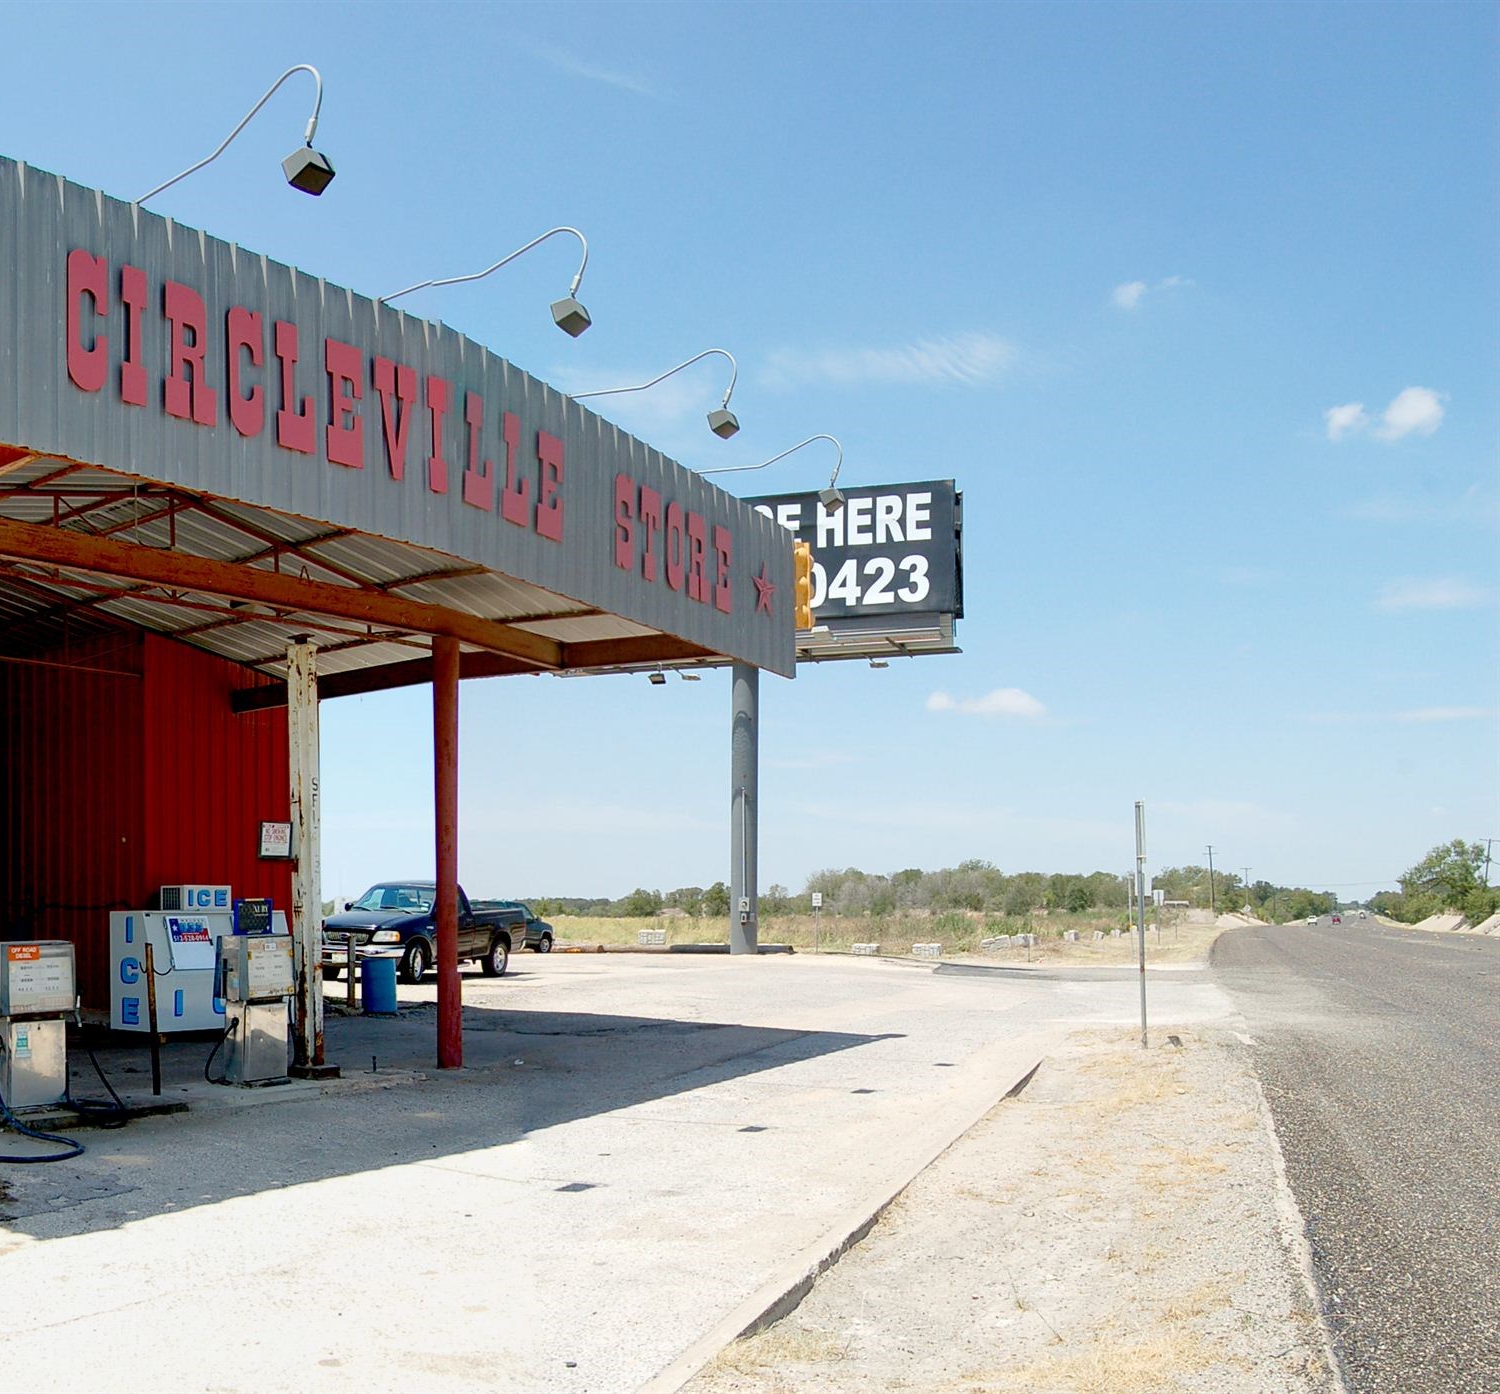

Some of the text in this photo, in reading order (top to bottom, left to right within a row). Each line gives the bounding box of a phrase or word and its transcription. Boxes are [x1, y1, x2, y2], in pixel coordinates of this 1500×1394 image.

[67, 248, 733, 614] CIRCLEVILLE STORE
[816, 492, 932, 549] HERE
[187, 889, 228, 907] ICE
[120, 916, 140, 1025] ICE
